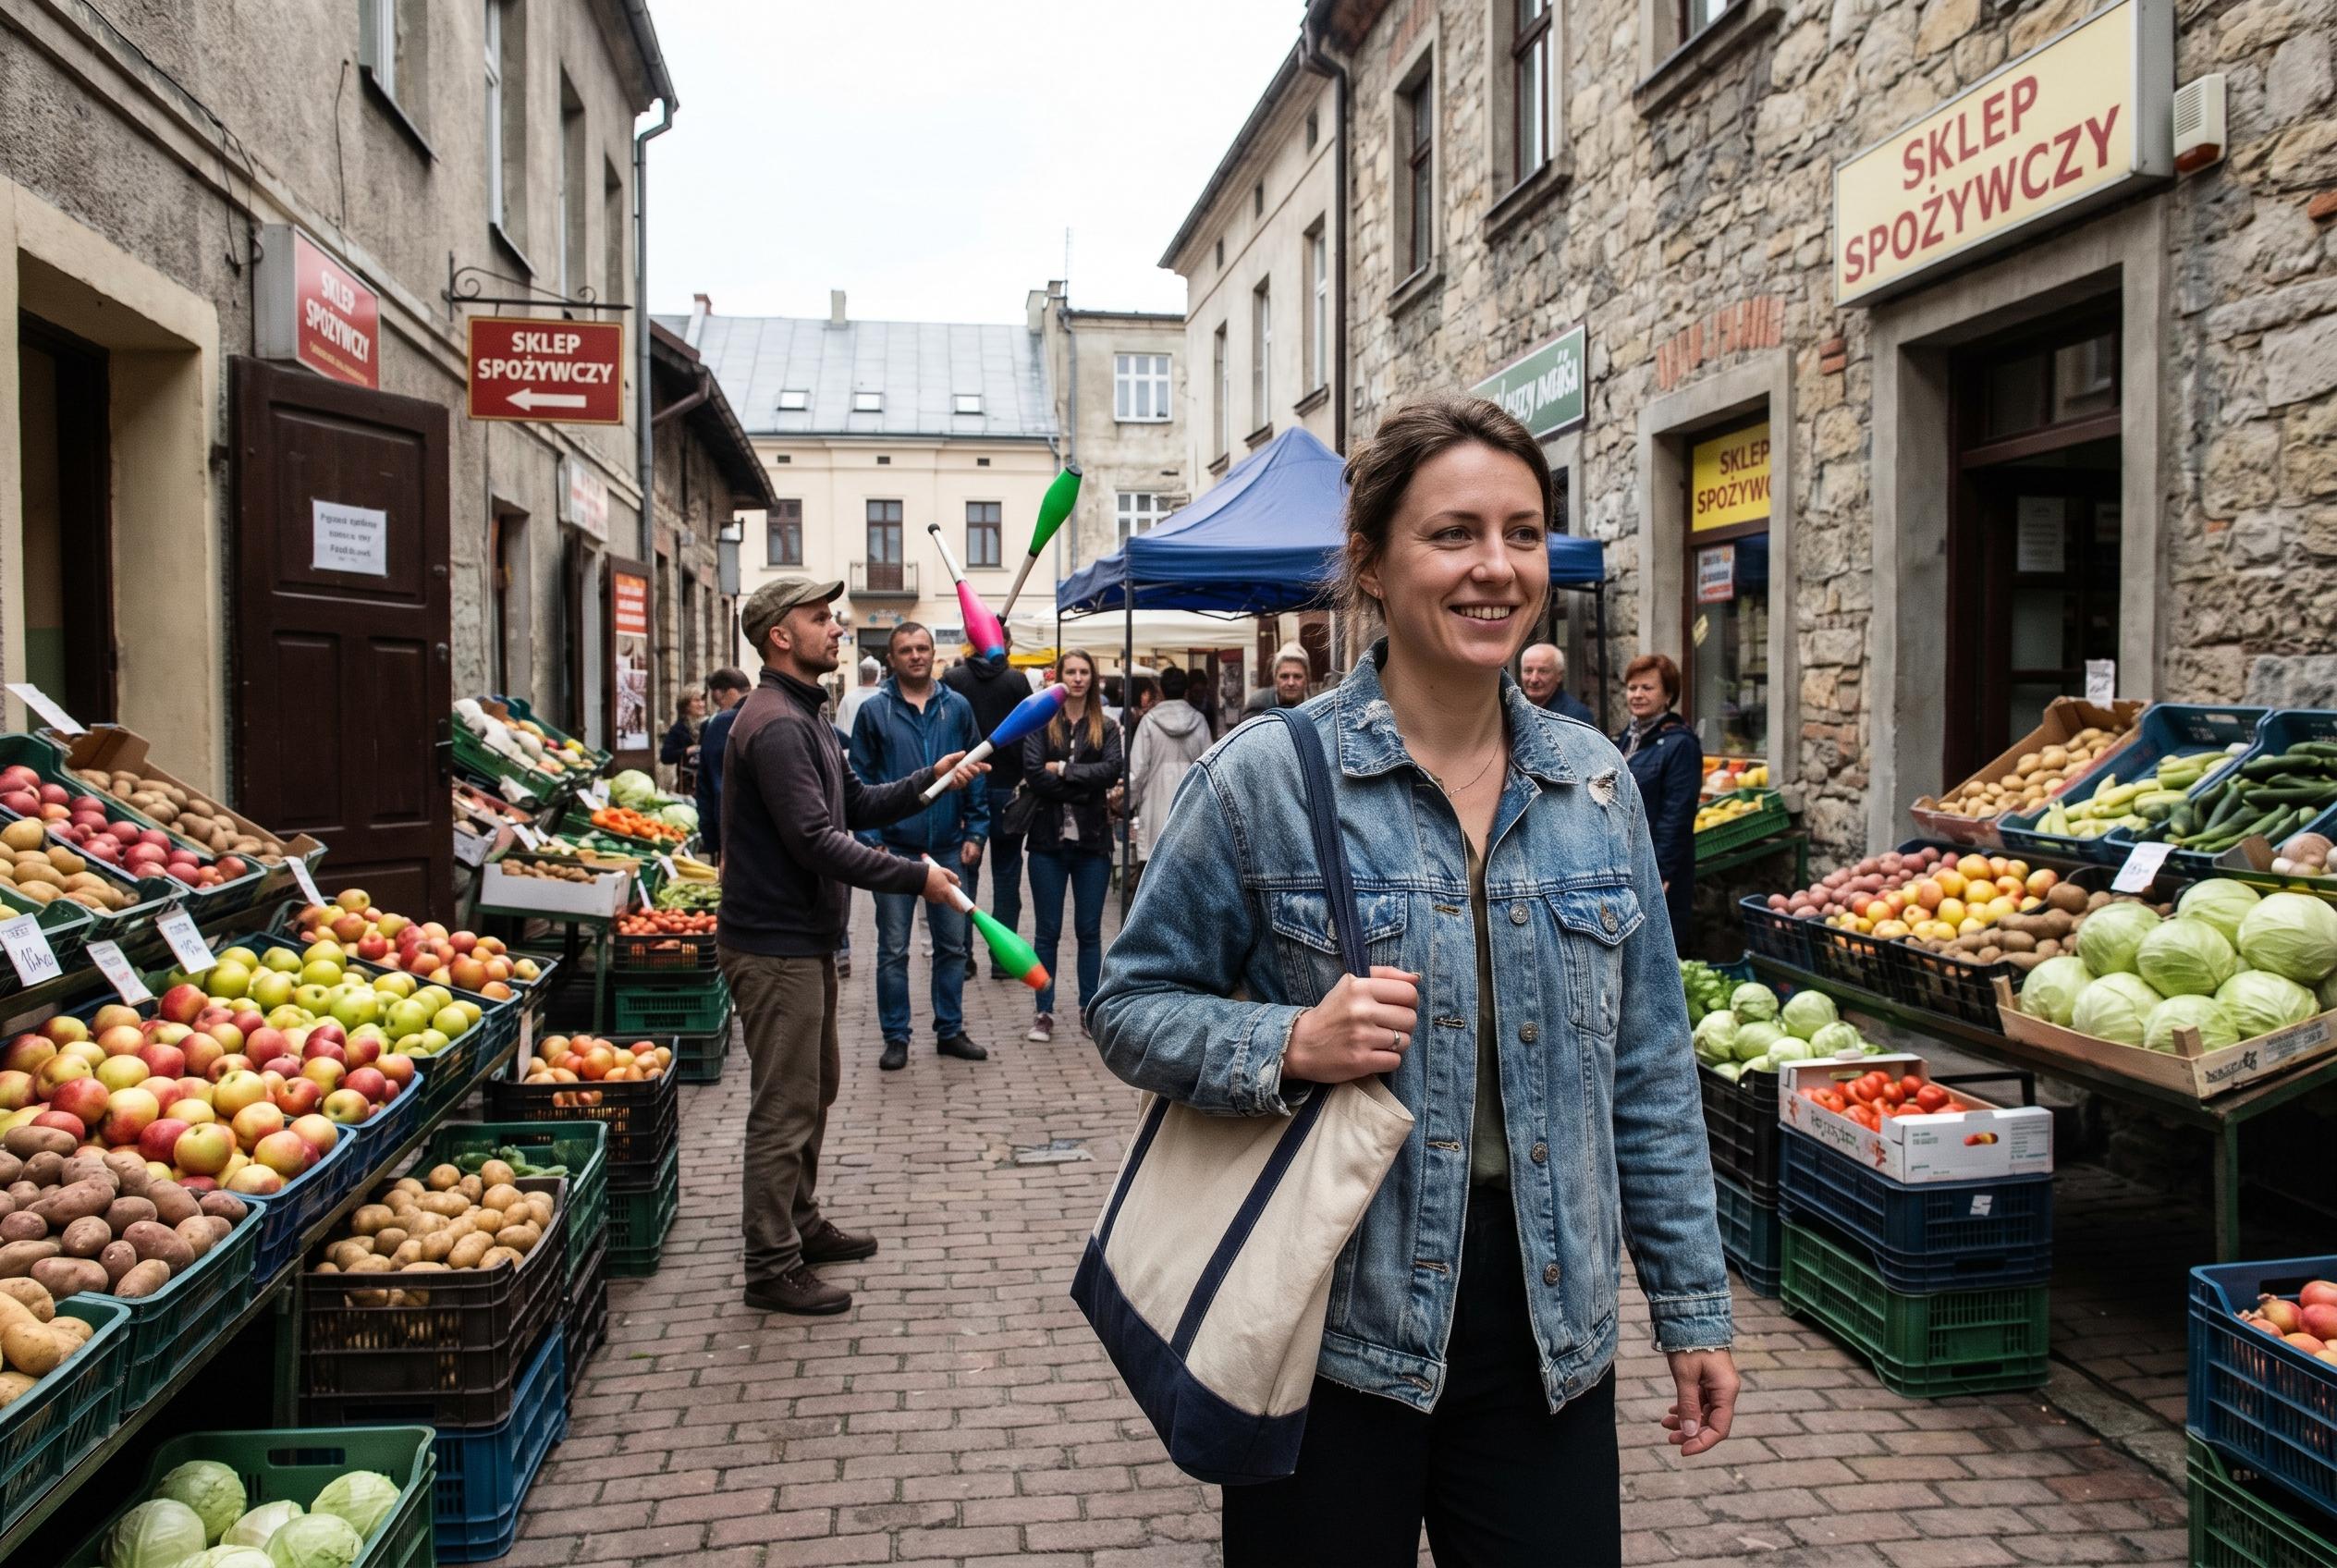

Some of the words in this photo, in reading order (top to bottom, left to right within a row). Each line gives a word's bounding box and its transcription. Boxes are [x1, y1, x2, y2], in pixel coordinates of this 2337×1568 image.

[1903, 75, 2039, 190] SKLEP
[1844, 104, 2121, 284] SPOŻYWCZY
[321, 270, 356, 315] SKLEP
[511, 331, 581, 354] SKLEP
[477, 355, 614, 384] SPOŻYWCZY
